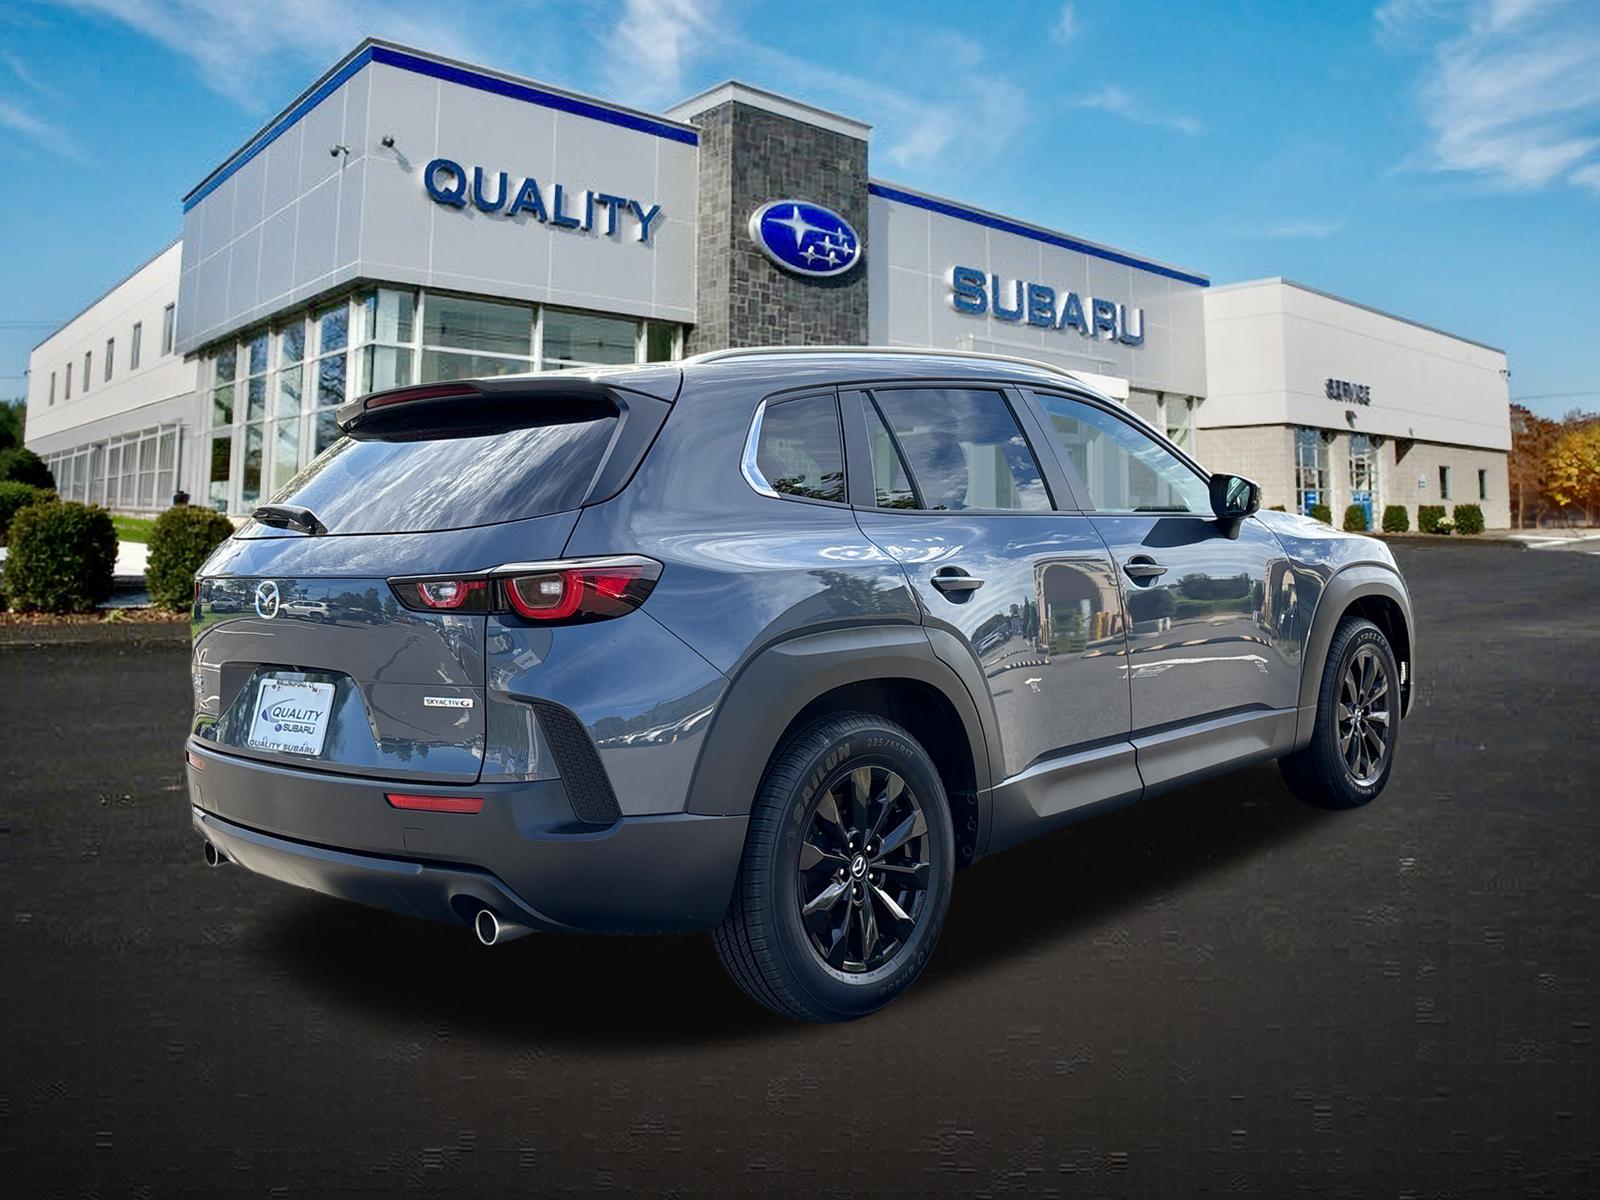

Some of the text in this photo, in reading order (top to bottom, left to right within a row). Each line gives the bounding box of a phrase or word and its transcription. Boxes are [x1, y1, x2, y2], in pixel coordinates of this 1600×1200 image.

[423, 158, 662, 243] QUALITY
[949, 264, 1145, 347] SUBARU
[272, 706, 323, 722] QUALITY
[282, 723, 316, 735] SUBARU
[249, 739, 281, 750] QUALITY
[282, 743, 316, 754] SUBARU
[866, 737, 914, 759] 225/65R17
[793, 742, 851, 824] SAILUN
